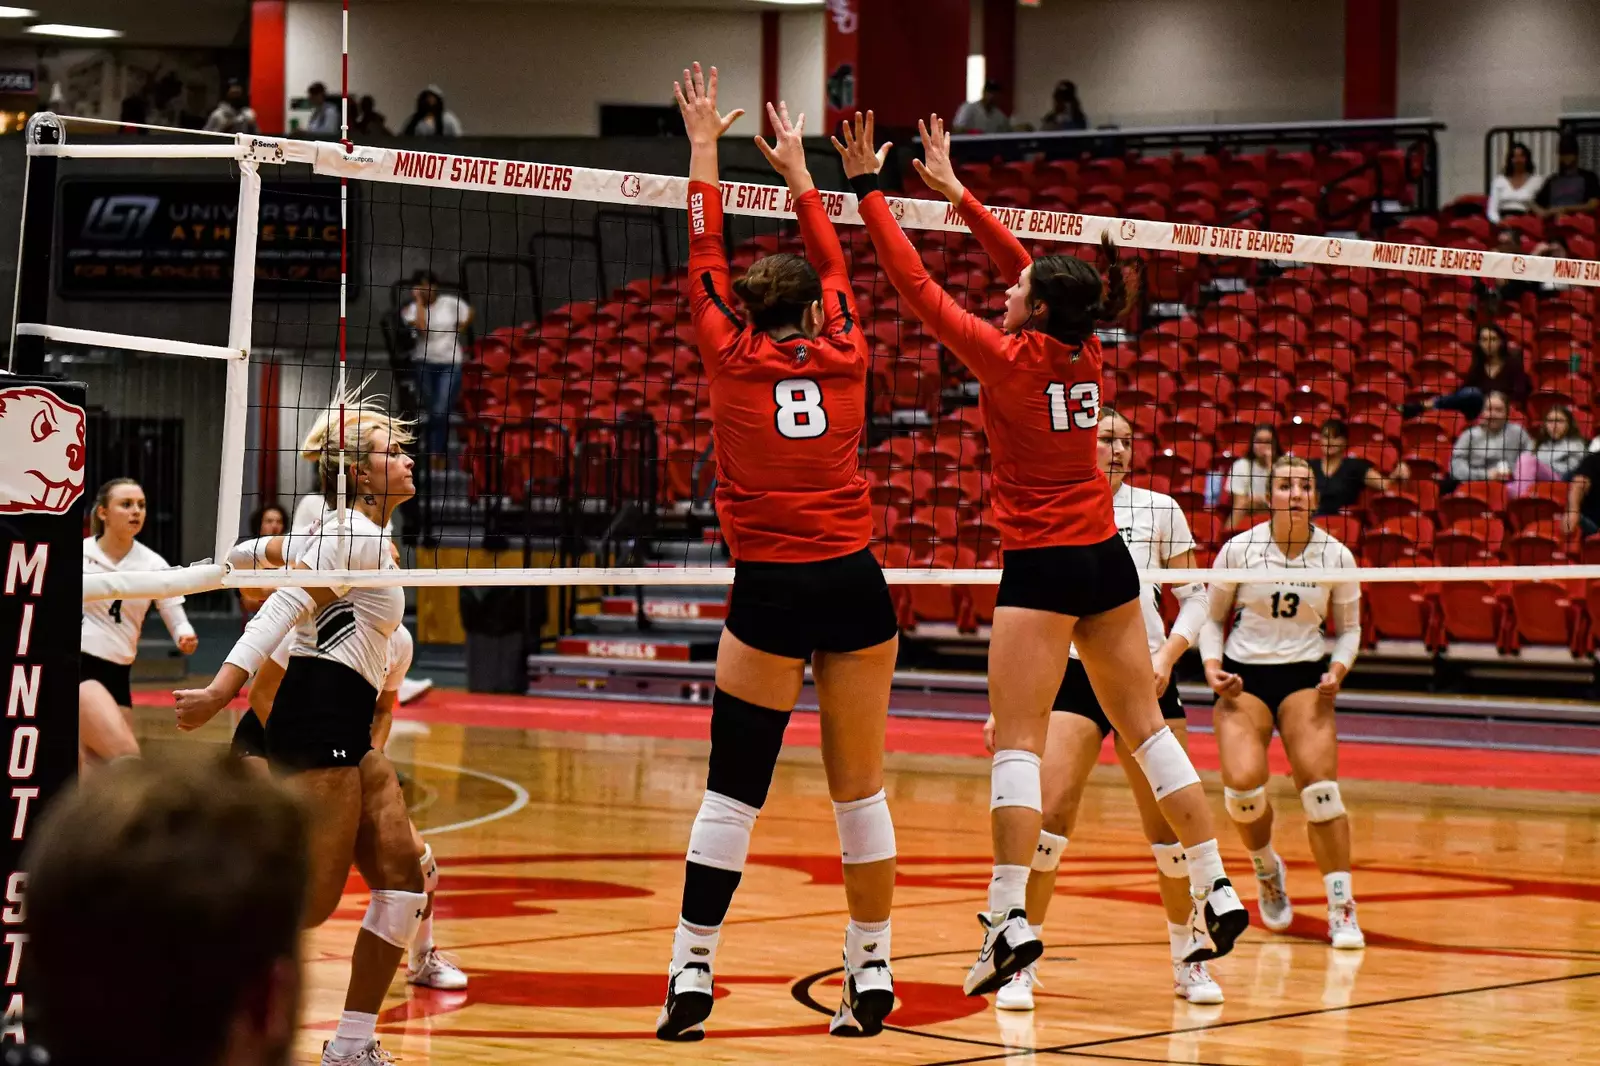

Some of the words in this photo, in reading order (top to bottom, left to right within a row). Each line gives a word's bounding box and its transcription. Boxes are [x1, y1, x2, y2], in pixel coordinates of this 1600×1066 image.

[393, 152, 447, 180] MINOT
[450, 158, 499, 185] STATE
[503, 162, 572, 191] BEAVERS
[737, 185, 779, 211] STATE
[169, 203, 338, 221] UNIVRSAL
[1029, 211, 1083, 236] BEAVERS
[171, 225, 338, 241] ATHETIC
[1172, 224, 1208, 246] MINOT
[1210, 227, 1243, 250] STATE
[1247, 231, 1294, 254] BEAVERS
[1373, 244, 1405, 264] MINOT
[1407, 247, 1437, 268] STATE
[1440, 249, 1484, 271] BEAVERS
[1553, 260, 1583, 279] MINOT
[773, 376, 829, 441] 8
[1044, 381, 1100, 431] 13
[108, 599, 123, 624] 4
[1271, 591, 1300, 619] 13
[4, 541, 49, 841] MINOT
